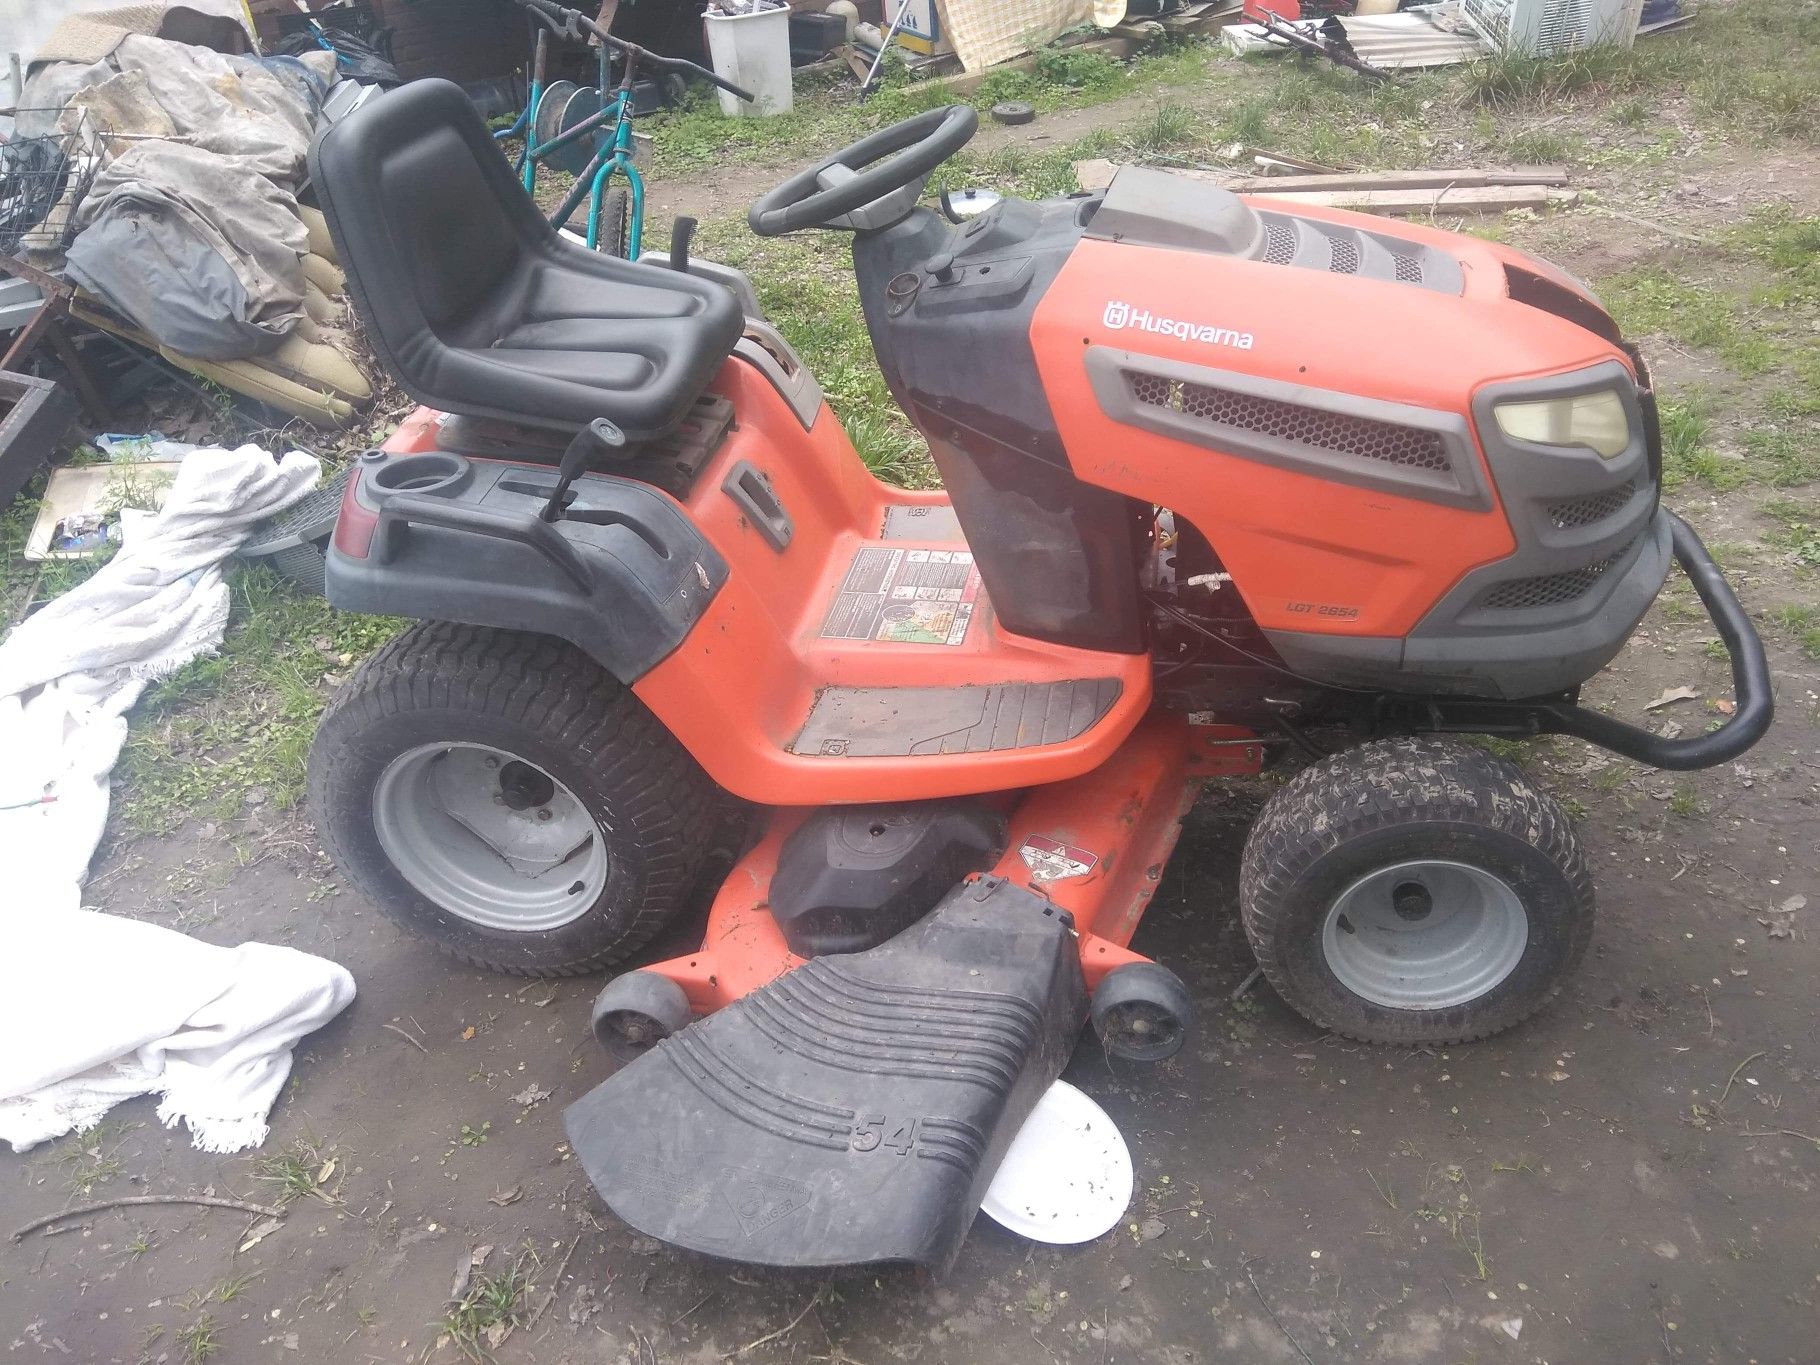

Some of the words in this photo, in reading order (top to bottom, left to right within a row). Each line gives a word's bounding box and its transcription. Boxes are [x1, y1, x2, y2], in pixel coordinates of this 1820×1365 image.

[1130, 308, 1254, 350] Husqvarna
[1287, 602, 1314, 613] LGT
[1319, 606, 1358, 617] 2654
[851, 1114, 916, 1156] 54
